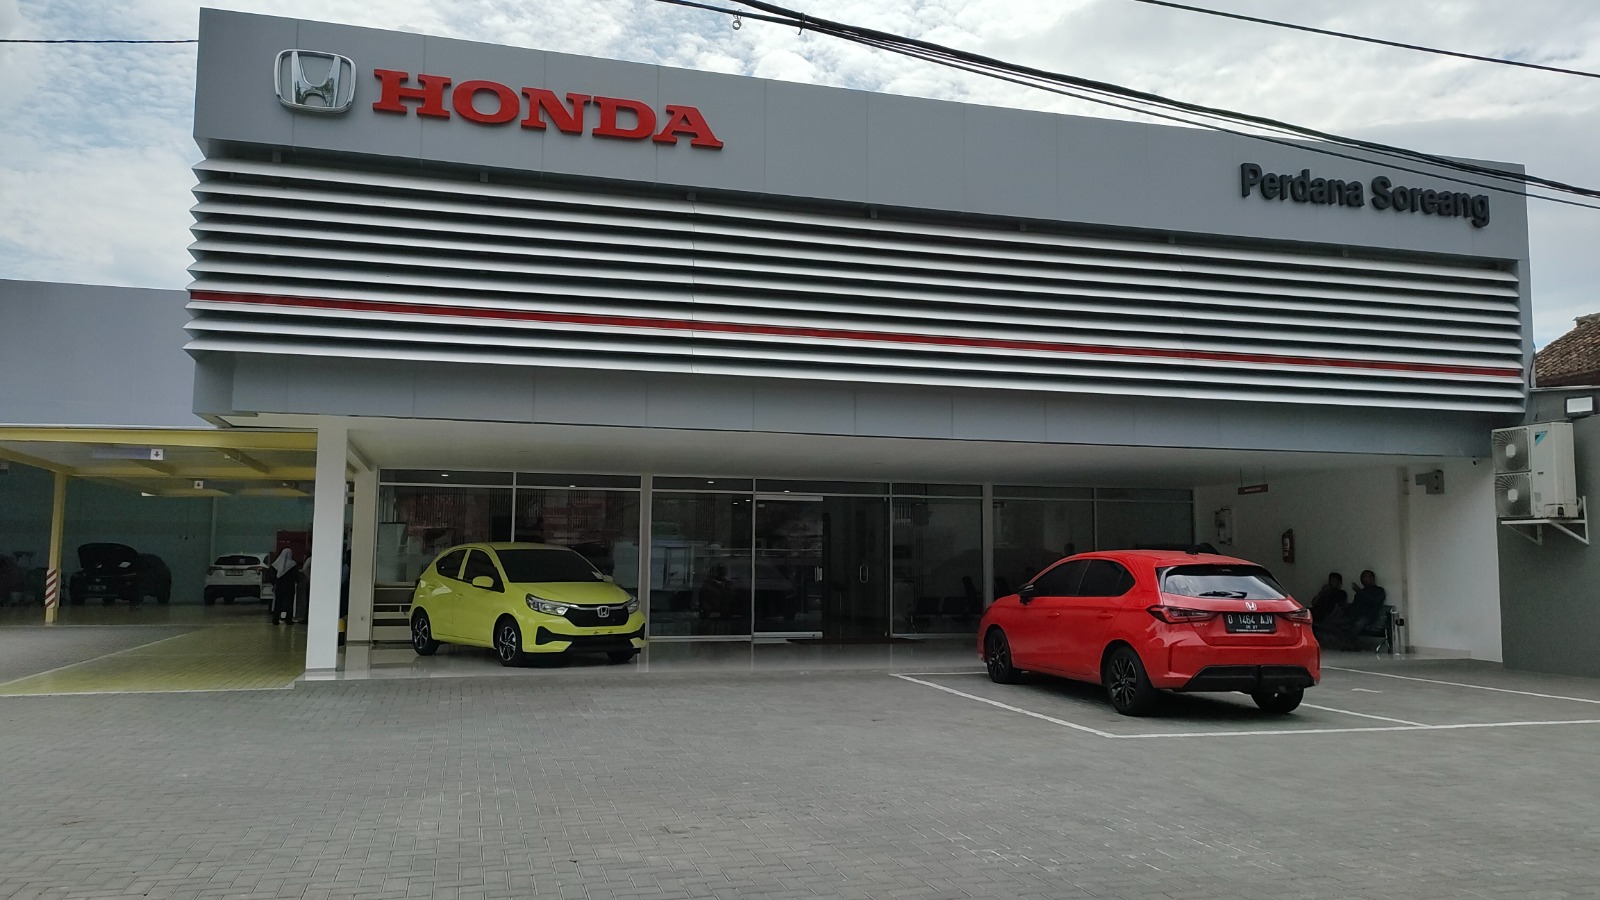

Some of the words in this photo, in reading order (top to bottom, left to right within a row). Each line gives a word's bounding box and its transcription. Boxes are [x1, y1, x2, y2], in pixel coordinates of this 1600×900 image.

[372, 68, 724, 150] HONDA
[1240, 162, 1365, 208] Perdana
[1371, 175, 1491, 229] Soreang
[1238, 614, 1256, 625] 1464
[1260, 614, 1273, 625] AJV
